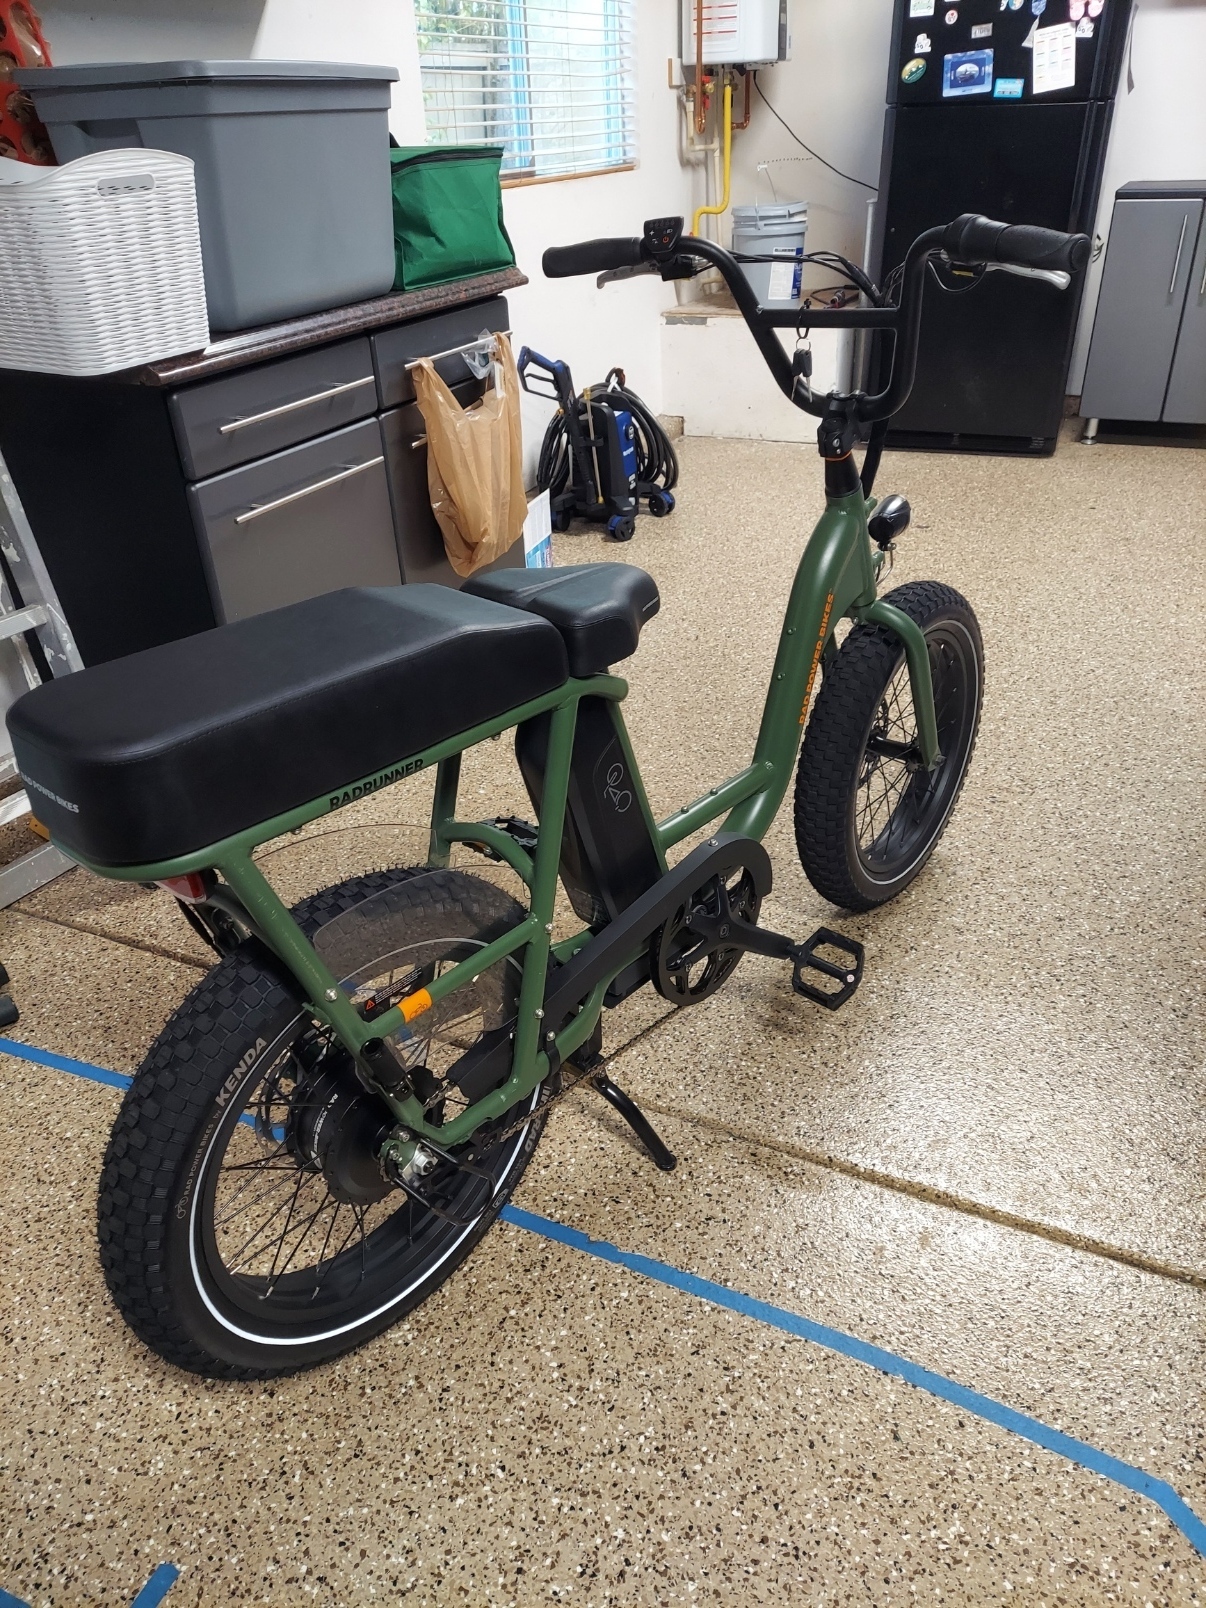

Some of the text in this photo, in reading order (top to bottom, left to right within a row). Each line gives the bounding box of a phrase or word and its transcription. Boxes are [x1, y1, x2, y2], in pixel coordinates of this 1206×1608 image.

[806, 640, 823, 692] POWER
[819, 593, 834, 637] BIKES
[56, 795, 79, 814] BIKES
[329, 758, 424, 810] RADRUNNER
[183, 1178, 193, 1196] RAD
[189, 1148, 204, 1177] POWER
[200, 1123, 214, 1146] BIKES
[215, 1037, 267, 1107] KENDA
